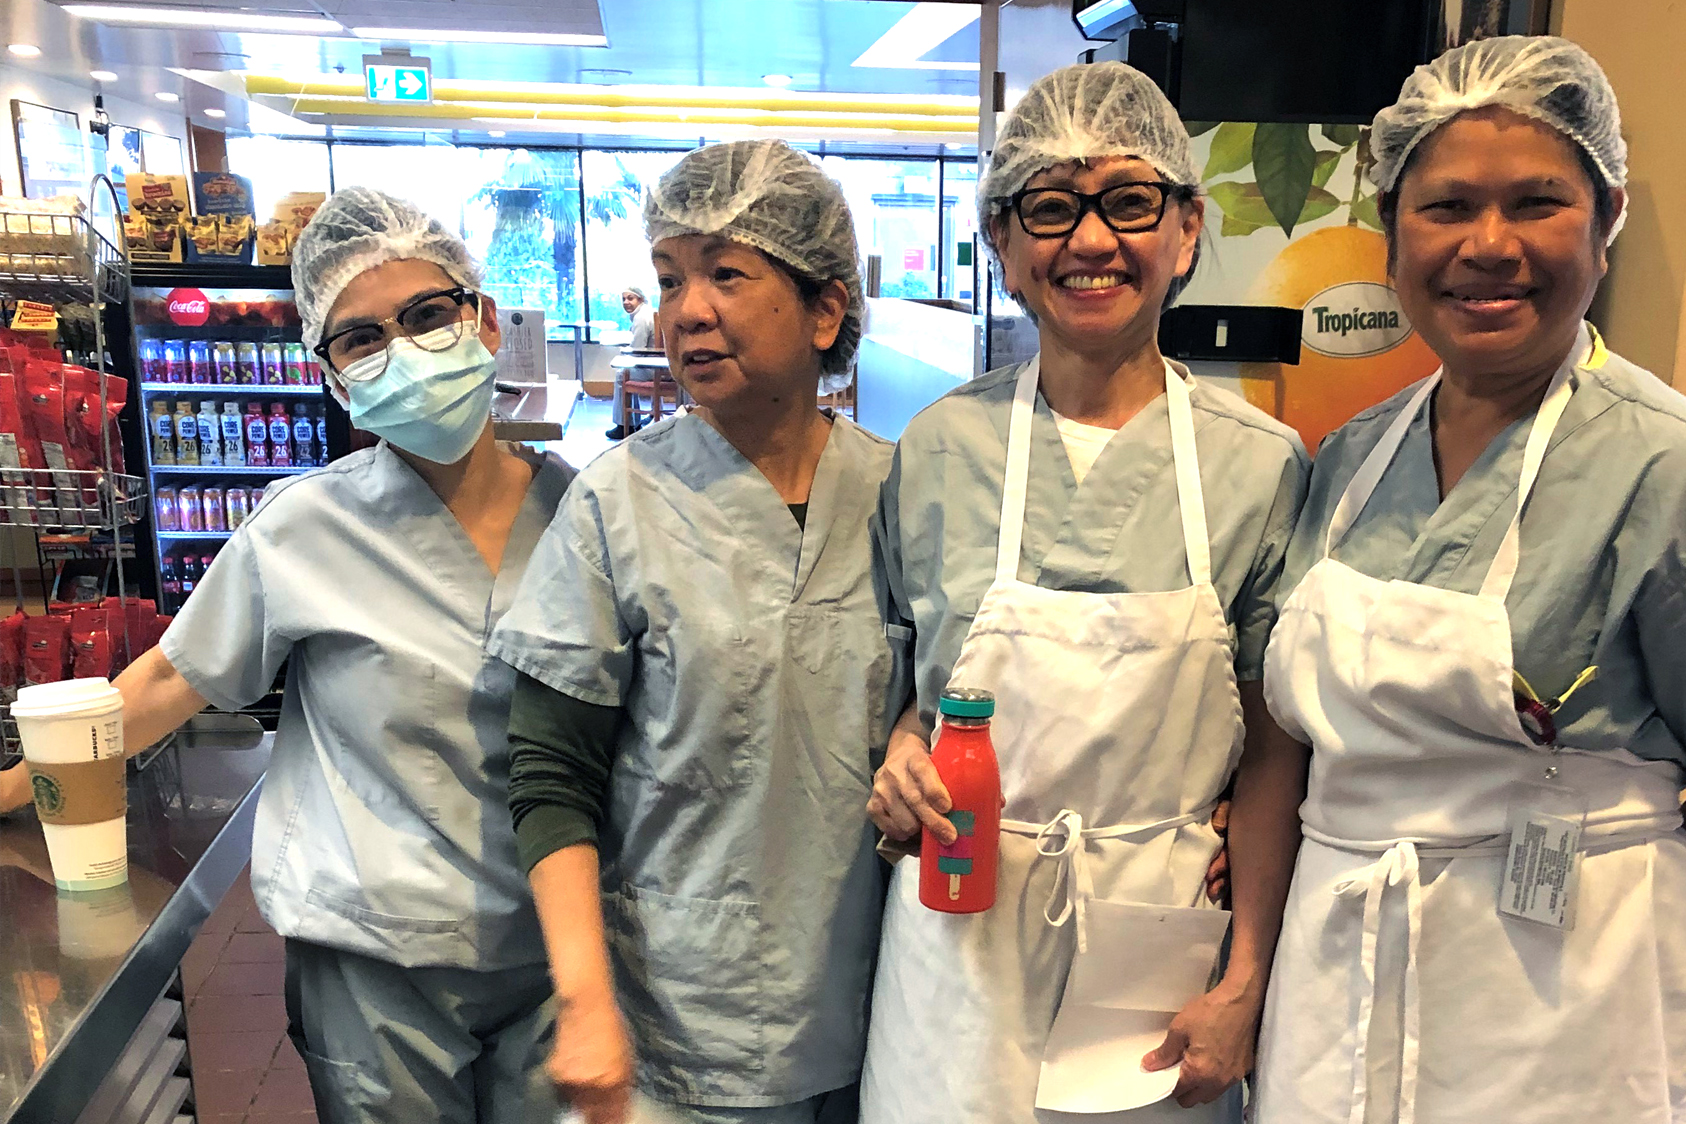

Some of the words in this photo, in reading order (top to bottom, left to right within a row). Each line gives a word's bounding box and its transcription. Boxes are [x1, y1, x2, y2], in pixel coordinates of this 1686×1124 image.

[1312, 306, 1399, 337] Tropicana
[506, 338, 533, 350] CLOSED
[185, 441, 196, 451] 26
[202, 444, 211, 455] 26
[228, 441, 239, 451] 26
[254, 446, 265, 457] 26
[275, 446, 287, 457] 26
